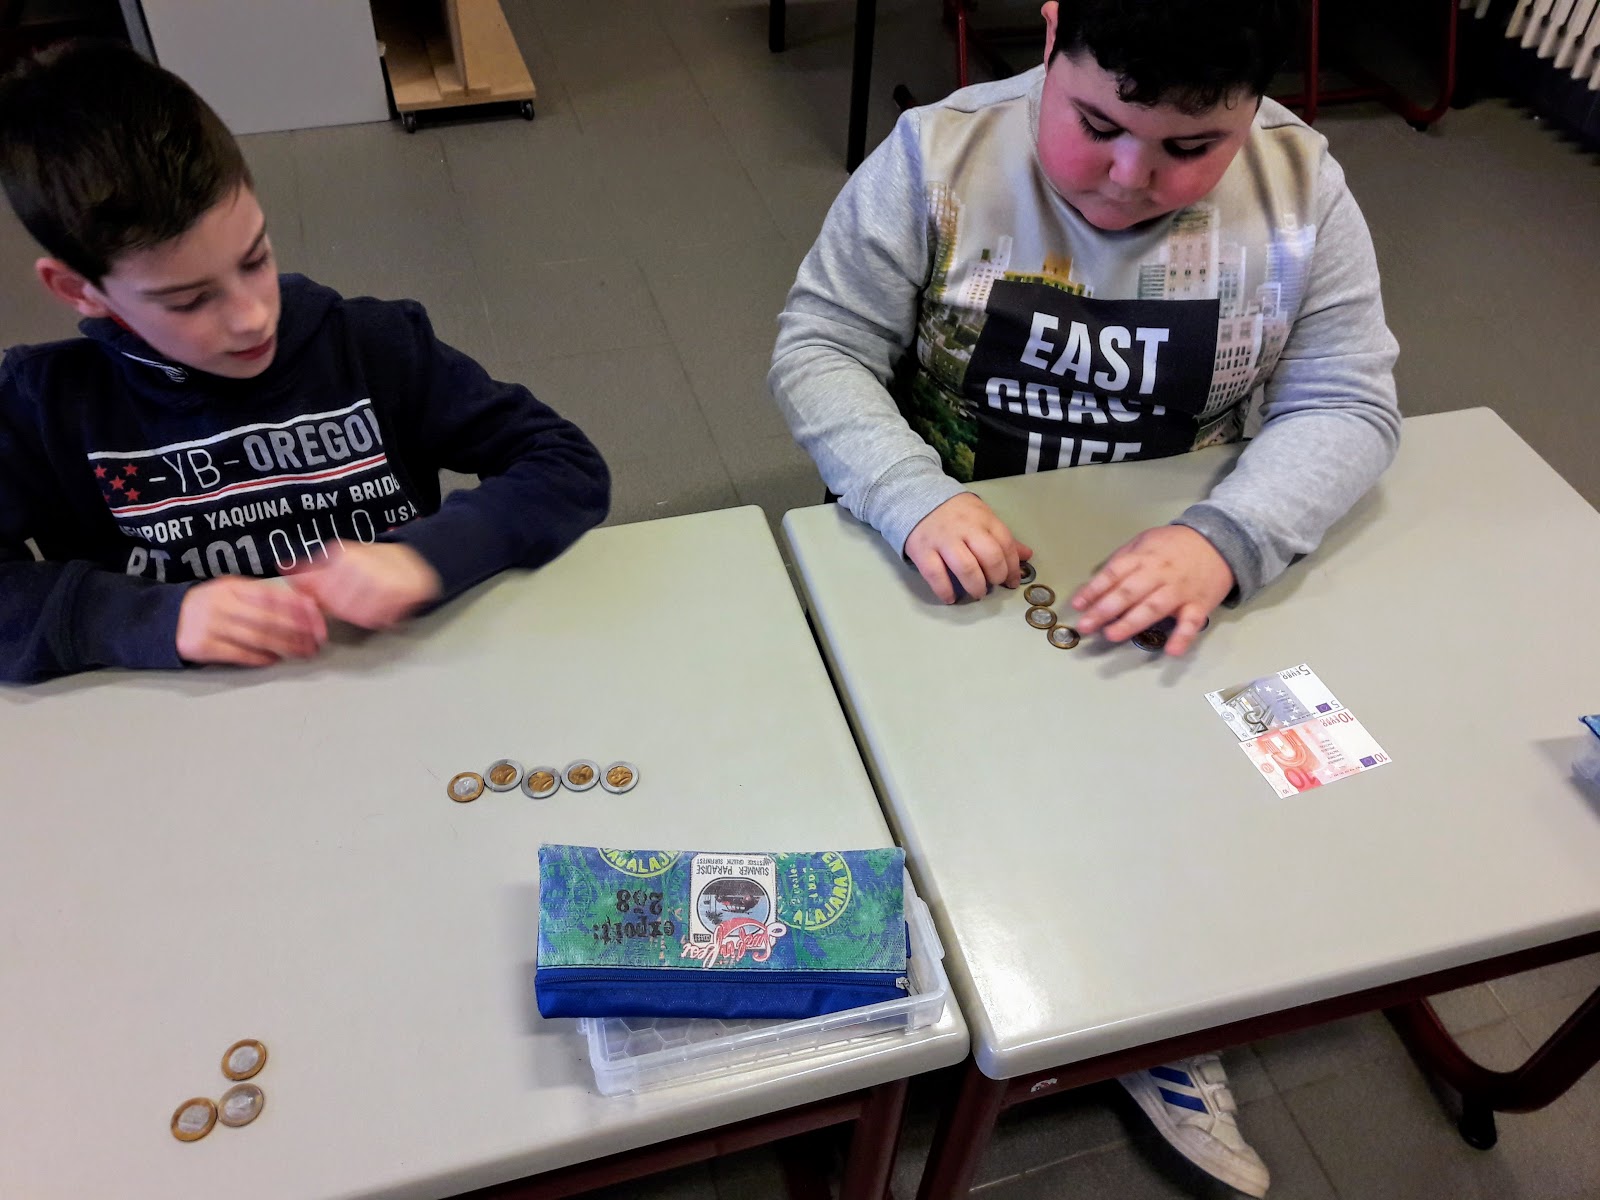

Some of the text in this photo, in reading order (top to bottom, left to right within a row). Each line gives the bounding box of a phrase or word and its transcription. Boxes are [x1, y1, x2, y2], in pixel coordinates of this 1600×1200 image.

[1020, 311, 1170, 395] EAST
[985, 377, 1166, 425] COA
[203, 498, 293, 531] YAQUINA
[302, 491, 339, 511] BAY
[181, 535, 264, 579] 101
[268, 508, 376, 571] OHIO
[696, 865, 770, 876] SUMMER PARADISE
